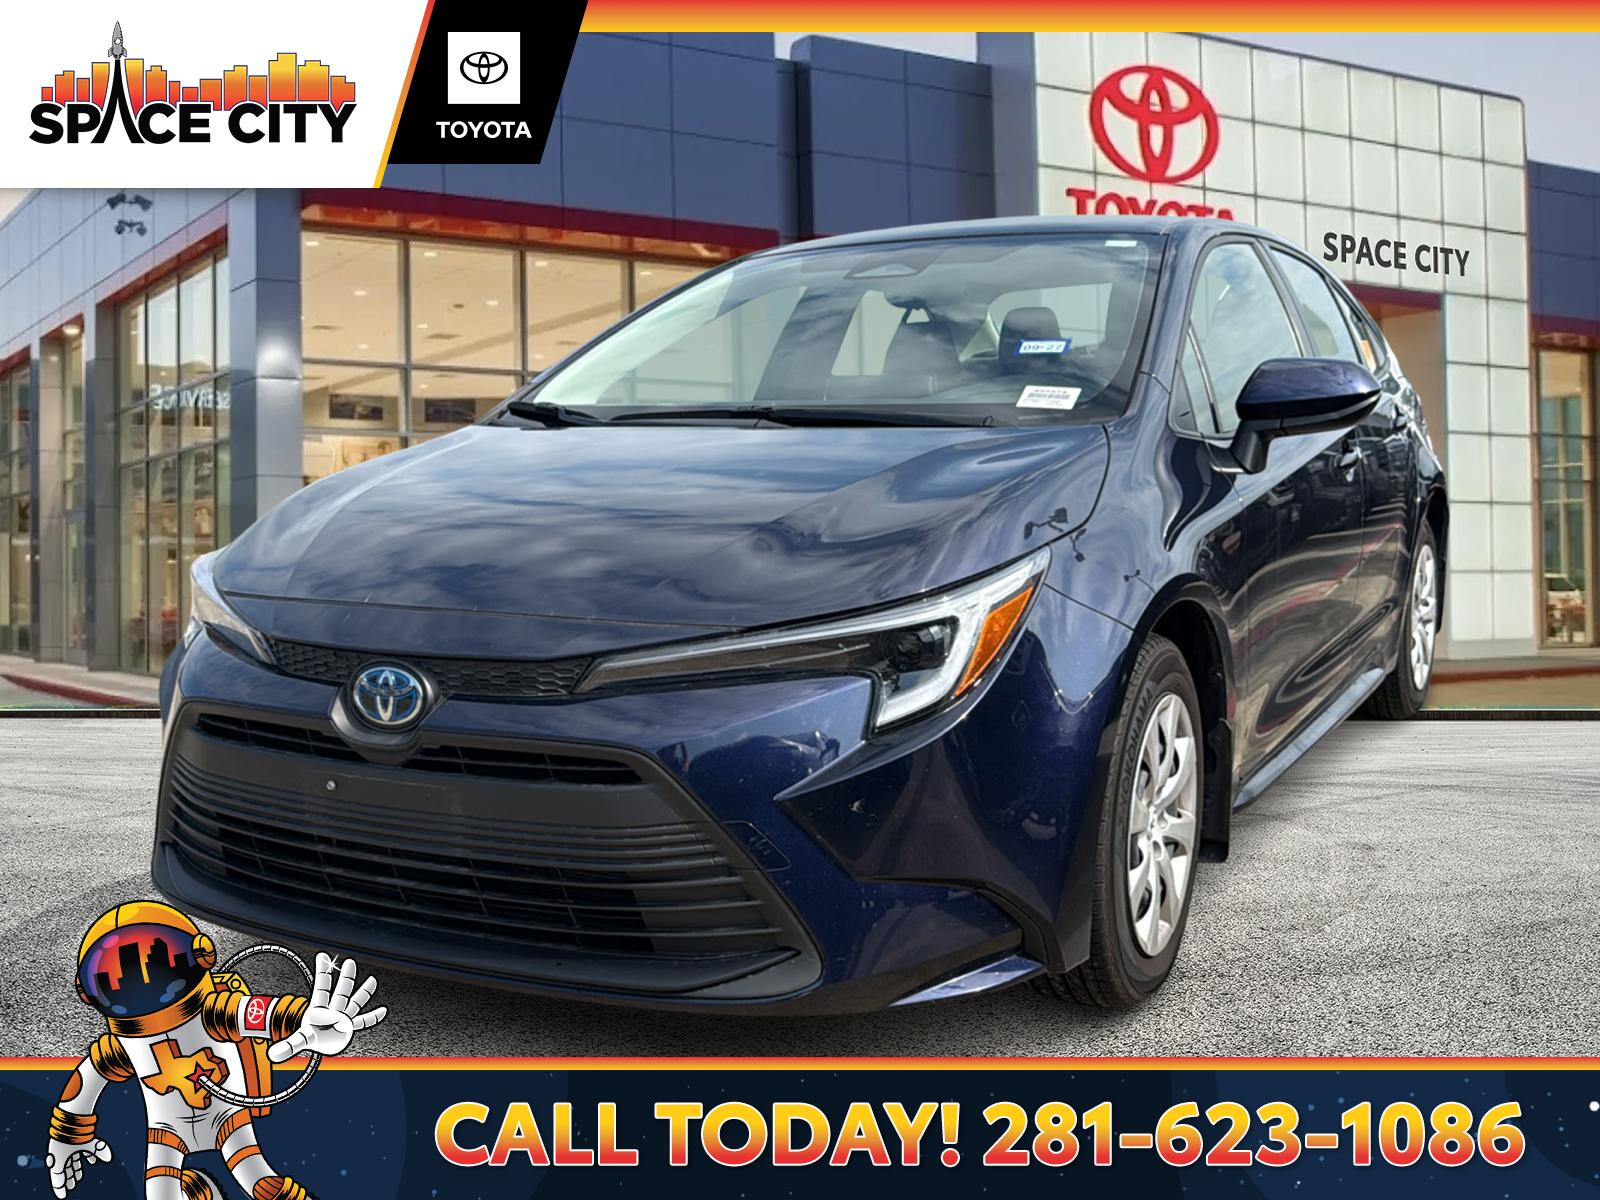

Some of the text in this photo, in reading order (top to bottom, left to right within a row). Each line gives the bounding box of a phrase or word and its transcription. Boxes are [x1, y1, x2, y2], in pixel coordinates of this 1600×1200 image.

[1323, 231, 1471, 277] SPACE CITY
[1119, 687, 1153, 807] YOKOHAMA
